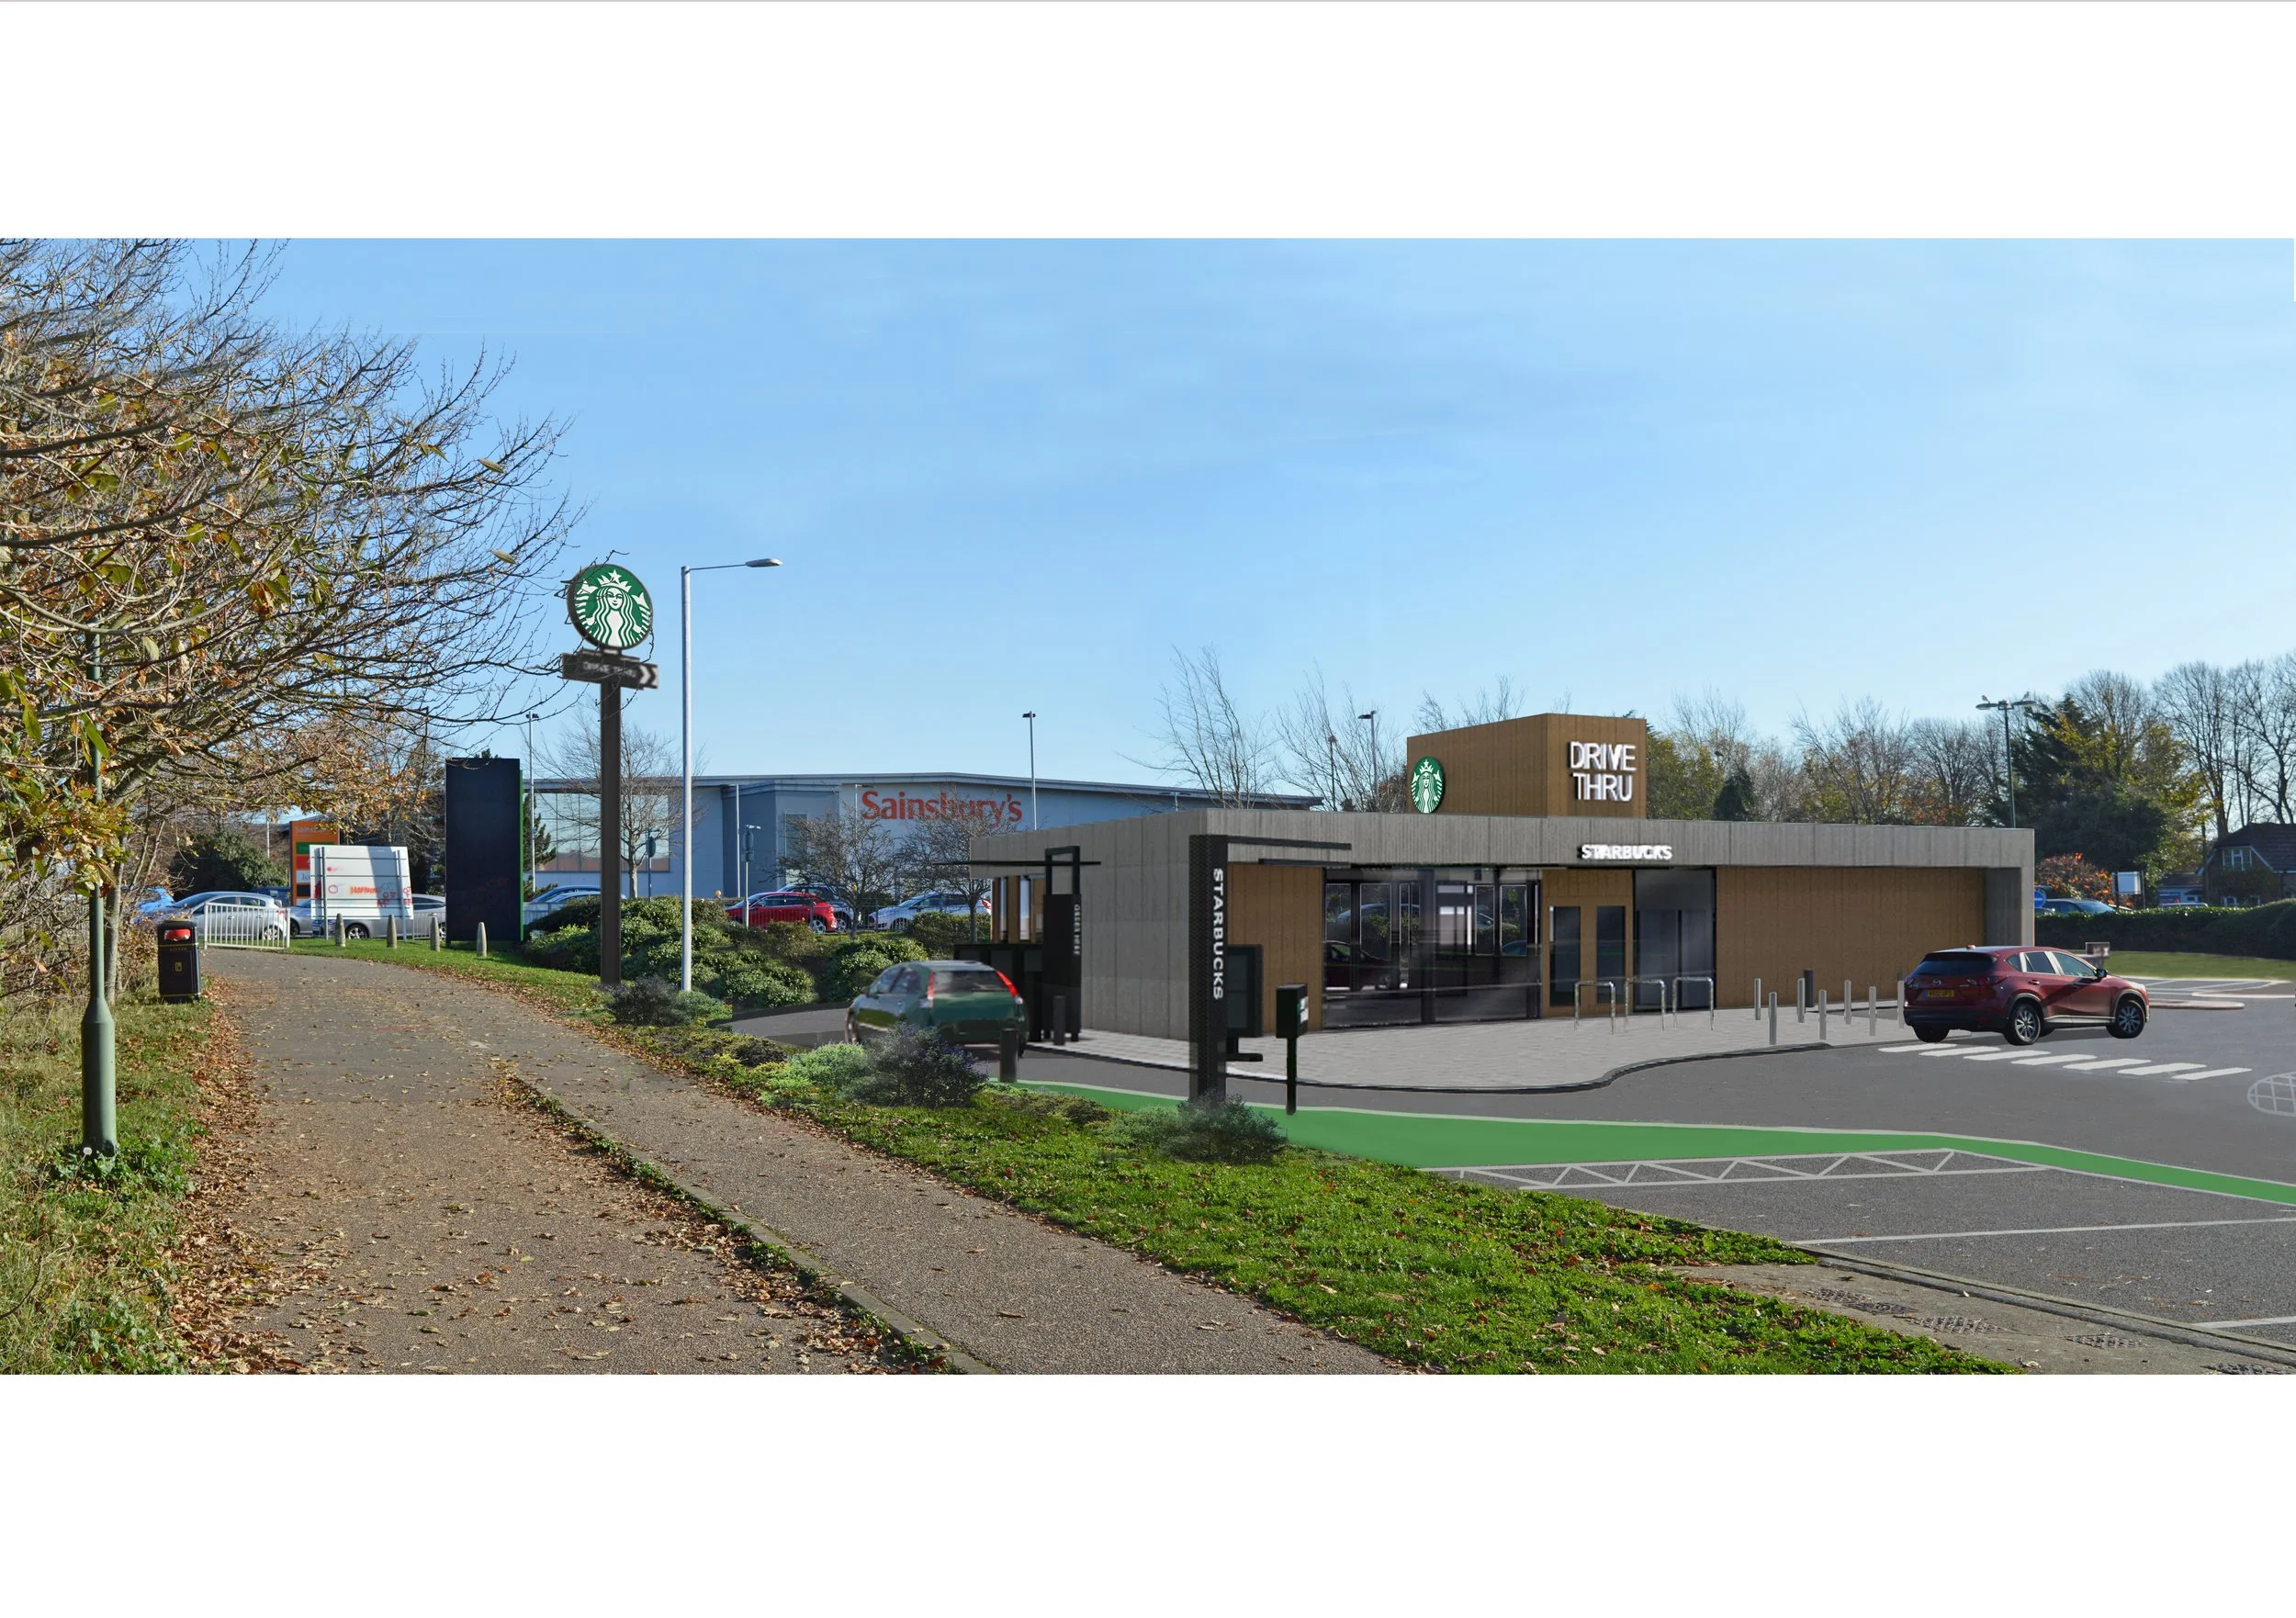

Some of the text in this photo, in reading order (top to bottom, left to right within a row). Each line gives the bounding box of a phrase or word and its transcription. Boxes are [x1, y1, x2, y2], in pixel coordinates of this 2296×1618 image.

[1570, 741, 1638, 771] DRIVE
[1571, 772, 1633, 802] THRU
[861, 791, 1022, 827] Sainsbury's
[1581, 844, 1672, 860] STARBUCKS
[1213, 868, 1224, 1000] STARBUCKS
